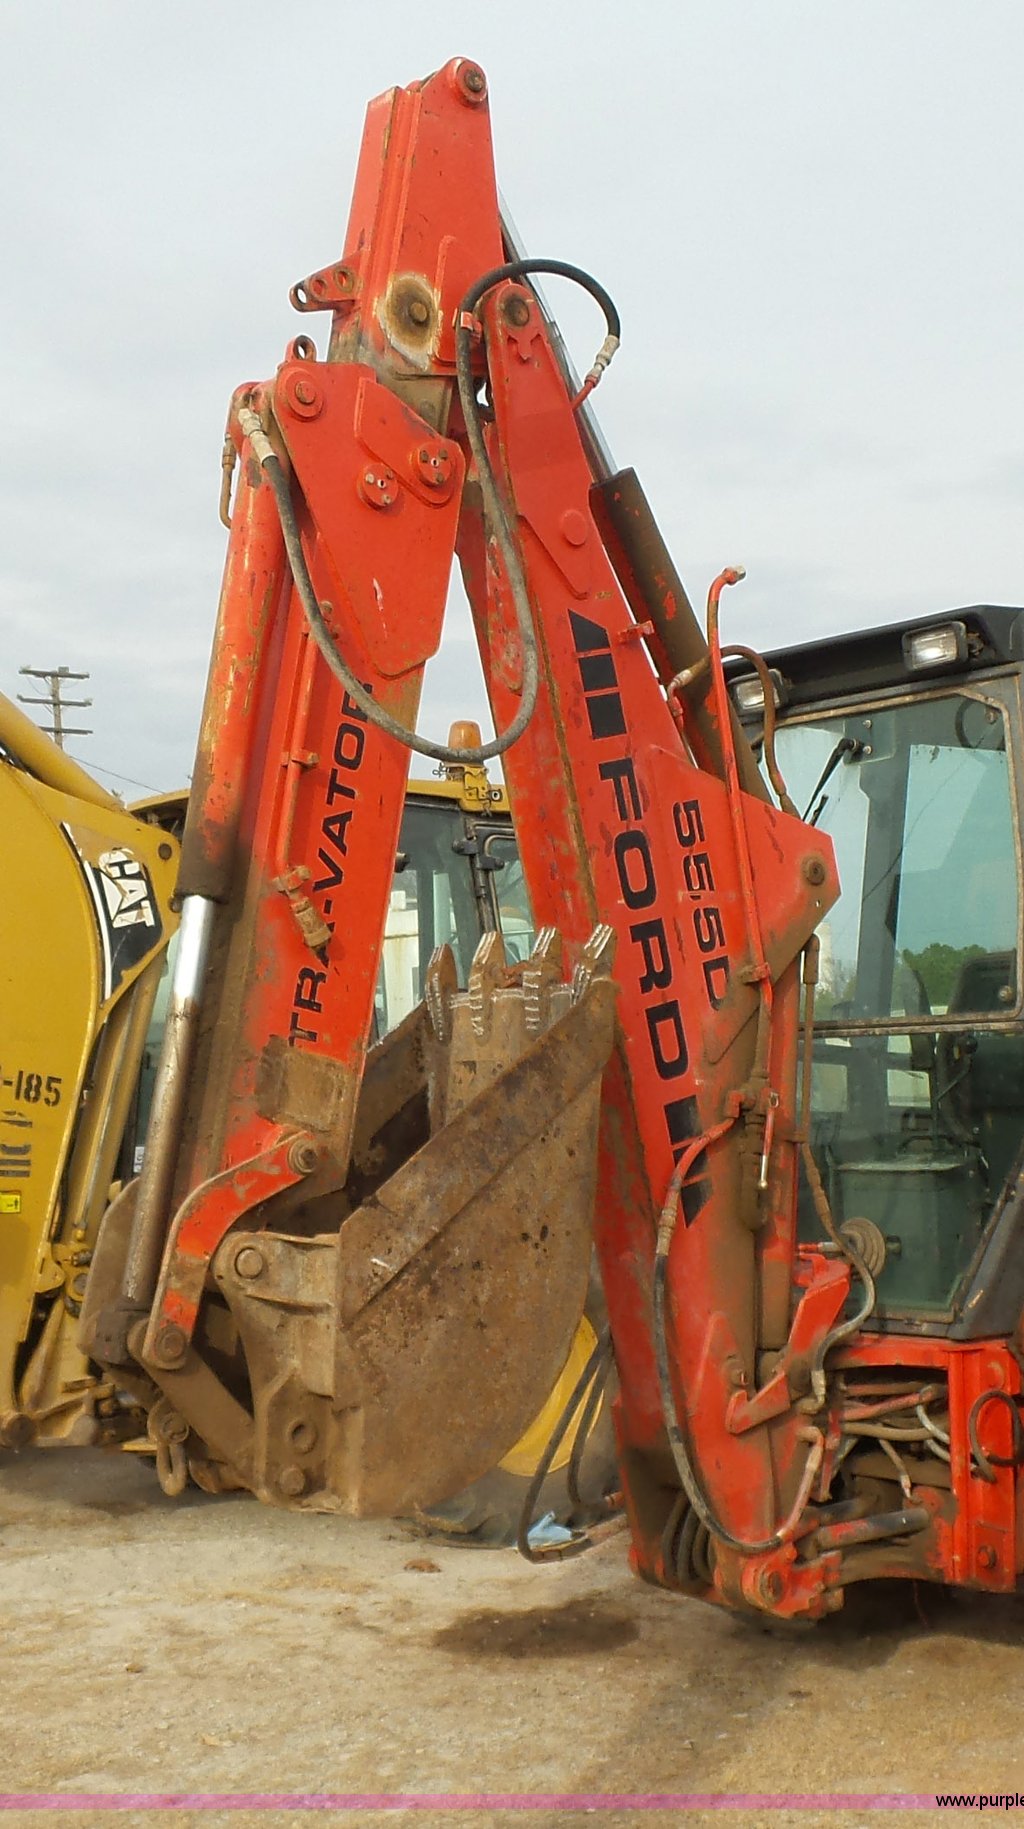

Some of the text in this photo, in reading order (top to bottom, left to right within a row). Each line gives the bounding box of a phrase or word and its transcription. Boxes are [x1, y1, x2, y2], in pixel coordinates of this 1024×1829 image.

[99, 848, 155, 929] CAT
[598, 756, 690, 1082] FORD
[0, 1065, 62, 1107] -185
